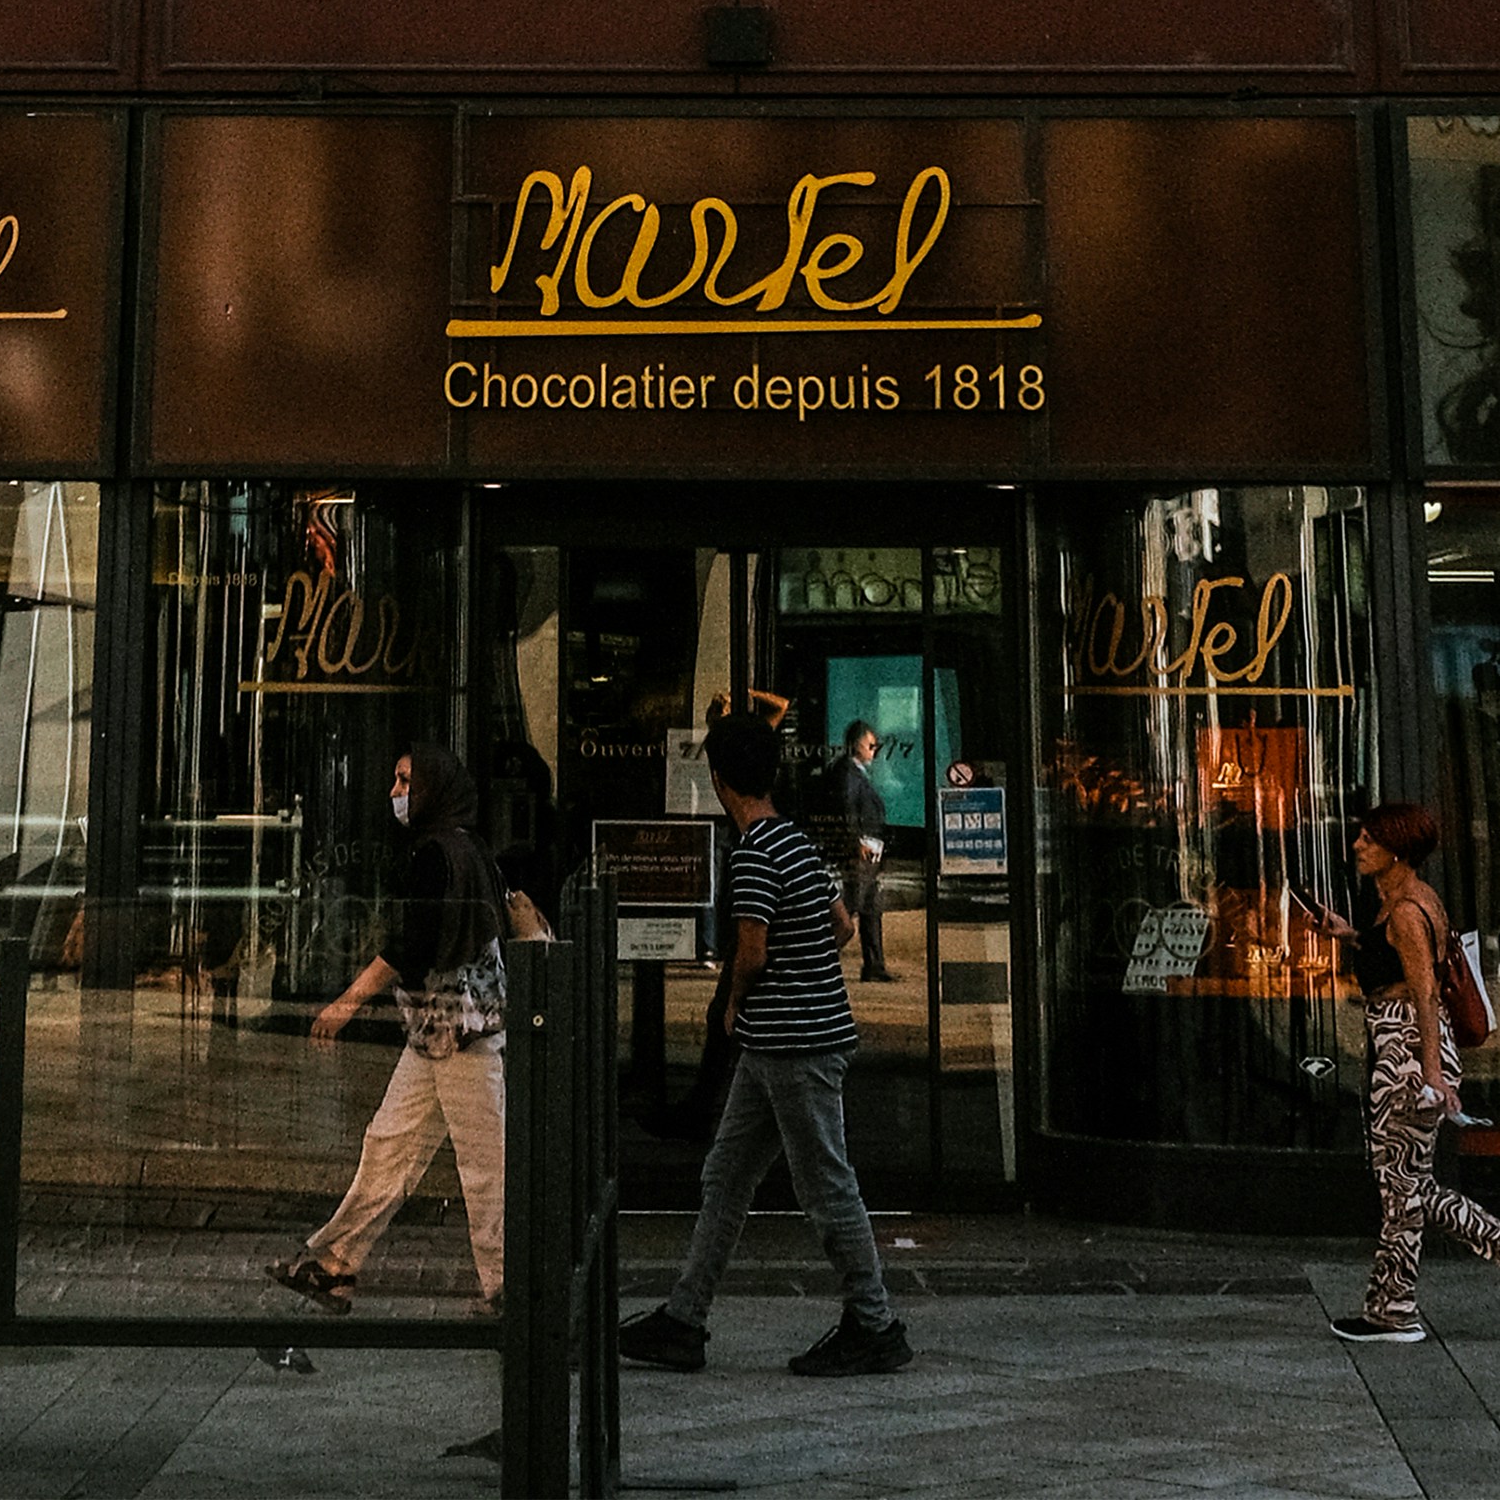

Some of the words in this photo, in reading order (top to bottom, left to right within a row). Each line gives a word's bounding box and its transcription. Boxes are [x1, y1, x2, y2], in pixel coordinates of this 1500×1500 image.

[491, 165, 951, 316] Martel
[444, 361, 717, 411] Chocolatier
[733, 363, 901, 422] depuis
[924, 364, 1046, 412] 1818
[679, 732, 711, 760] 7/
